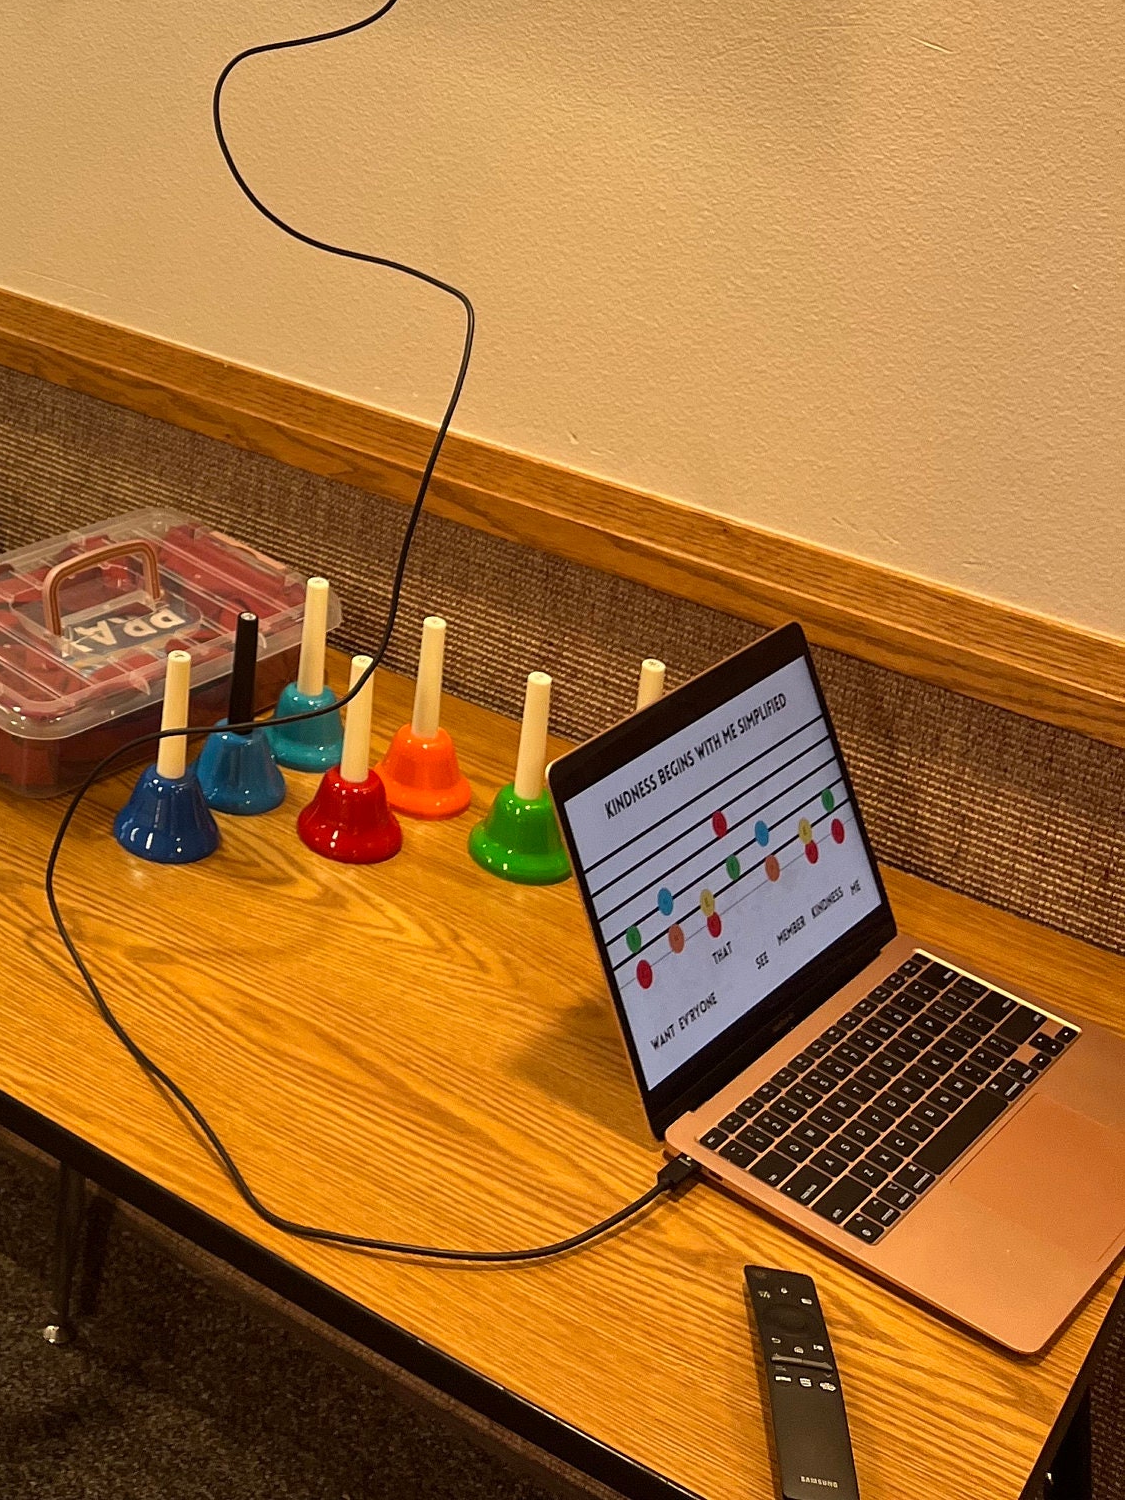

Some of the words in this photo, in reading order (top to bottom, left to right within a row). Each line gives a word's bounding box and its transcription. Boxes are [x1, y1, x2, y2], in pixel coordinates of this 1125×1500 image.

[604, 774, 658, 819] KINDNESS
[657, 749, 695, 786] BEGINS
[694, 736, 722, 761] WITH
[722, 723, 737, 747] ME
[737, 692, 787, 736] SIMPLIFIED
[755, 951, 770, 970] SEE
[777, 915, 806, 946] MEMBER
[811, 886, 844, 919] KINDNESS
[850, 879, 861, 896] ME
[712, 940, 733, 965] THAT
[650, 1022, 676, 1051] WANT
[800, 1476, 839, 1488] SAMSUNG
